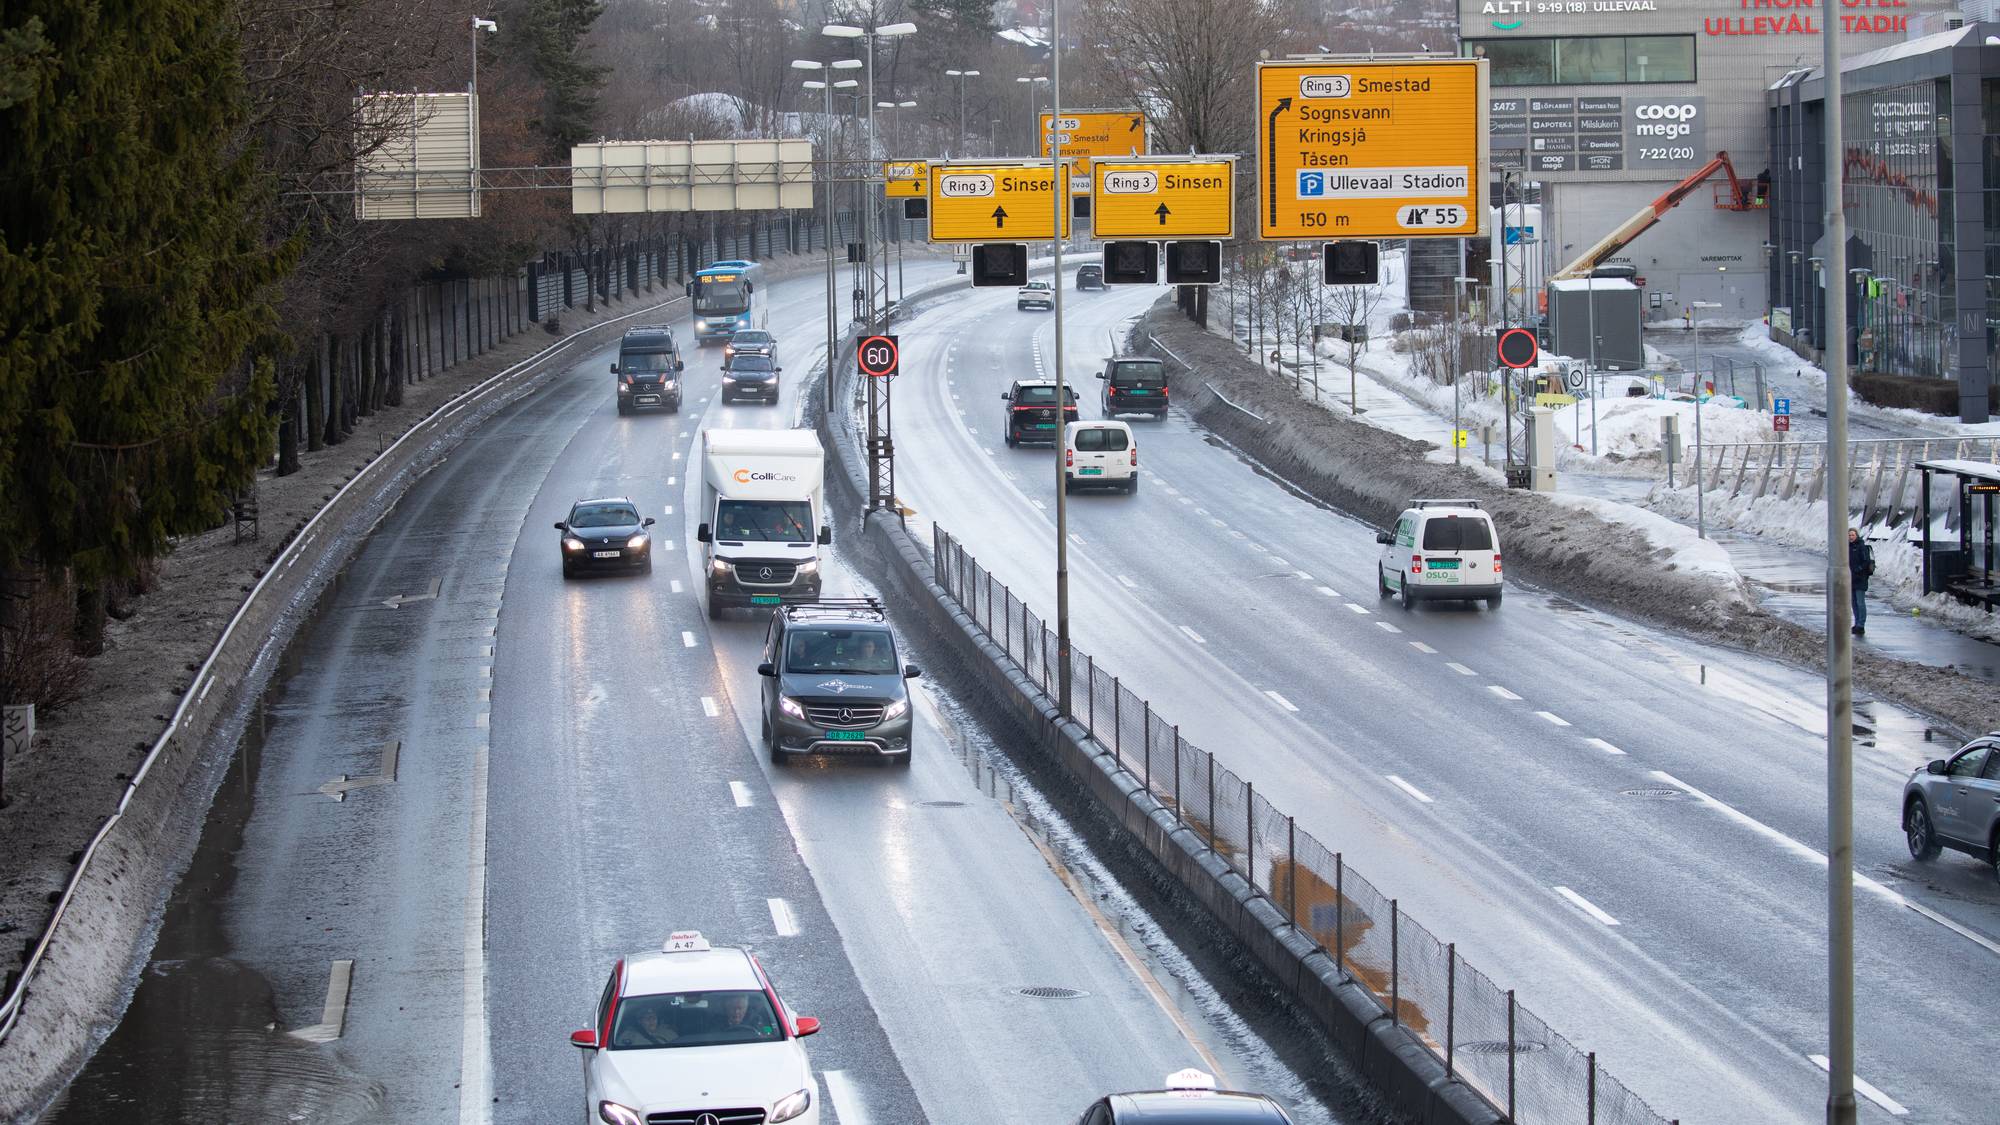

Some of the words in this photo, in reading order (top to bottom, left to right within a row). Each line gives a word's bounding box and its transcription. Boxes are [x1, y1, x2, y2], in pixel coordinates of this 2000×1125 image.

[1482, 1, 1531, 13] ALTI
[1537, 3, 1563, 13] 9-19
[1566, 2, 1587, 13] (18)
[1593, 1, 1657, 12] ULLEVAAL
[1839, 15, 1907, 33] TADI
[1306, 80, 1332, 93] Ring
[1335, 80, 1343, 92] 3
[1358, 77, 1431, 93] Smestad
[1492, 102, 1517, 111] SATS
[1635, 104, 1697, 122] coop
[1299, 106, 1391, 124] Sognsvann
[1064, 120, 1076, 128] 55
[1636, 123, 1691, 140] mega
[1073, 134, 1109, 142] Smestad
[1299, 128, 1366, 146] Kringsjå
[1300, 151, 1349, 166] Tåsen
[1639, 147, 1667, 160] 7-22
[1668, 146, 1695, 161] (20)
[949, 180, 976, 194] Ring
[979, 180, 987, 191] 3
[1112, 177, 1140, 190] Ring
[1142, 177, 1150, 188] 3
[1165, 175, 1223, 190] Sinsen
[1330, 175, 1393, 190] Ullevaal
[1402, 174, 1465, 189] Stadion
[1300, 213, 1327, 227] 150
[1335, 215, 1350, 227] m
[1435, 208, 1458, 224] 55
[1701, 255, 1743, 263] VAREMOTTAK
[867, 347, 889, 365] 60
[751, 472, 797, 482] ColliCare
[1426, 571, 1448, 579] OSLO
[684, 941, 694, 949] 47
